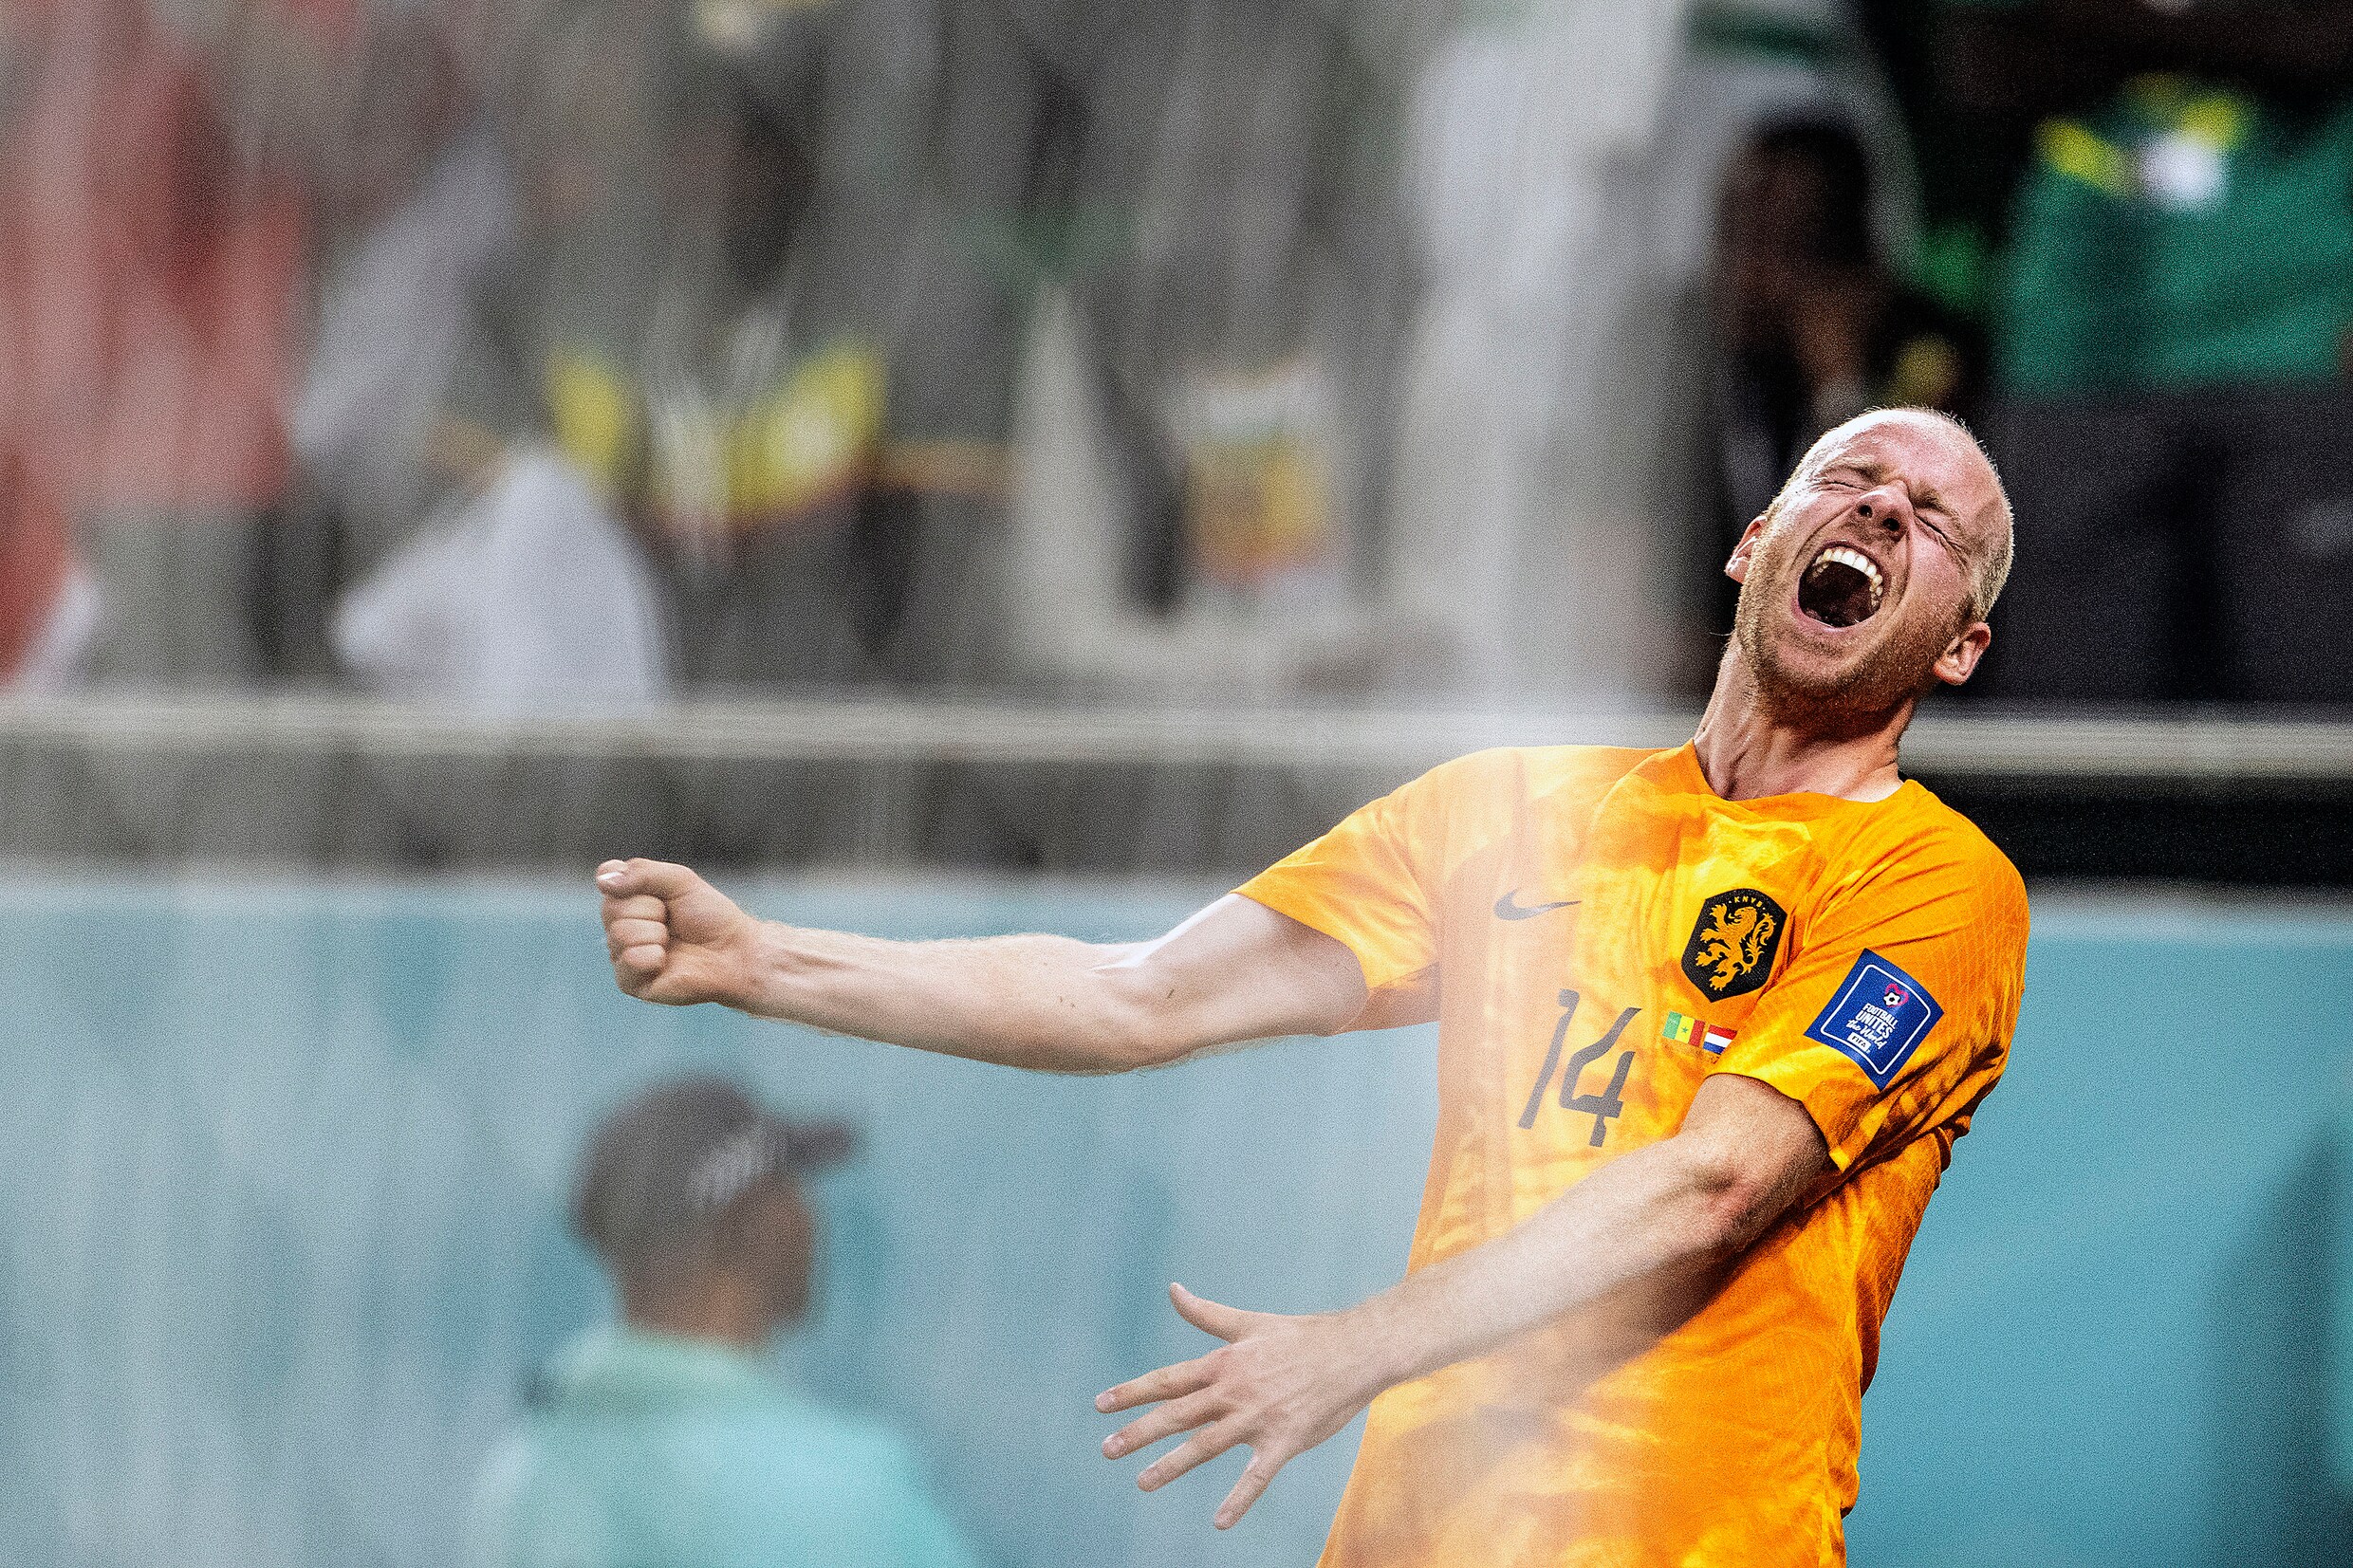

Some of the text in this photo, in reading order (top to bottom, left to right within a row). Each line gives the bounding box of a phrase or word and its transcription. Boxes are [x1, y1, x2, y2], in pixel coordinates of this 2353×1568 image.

[1734, 896, 1762, 907] KNVB
[1855, 1010, 1894, 1039] UNITES
[1862, 1003, 1898, 1029] FOOTBALL
[1845, 1019, 1887, 1049] the World
[1851, 1035, 1866, 1047] FIFA
[1518, 988, 1642, 1148] 14
